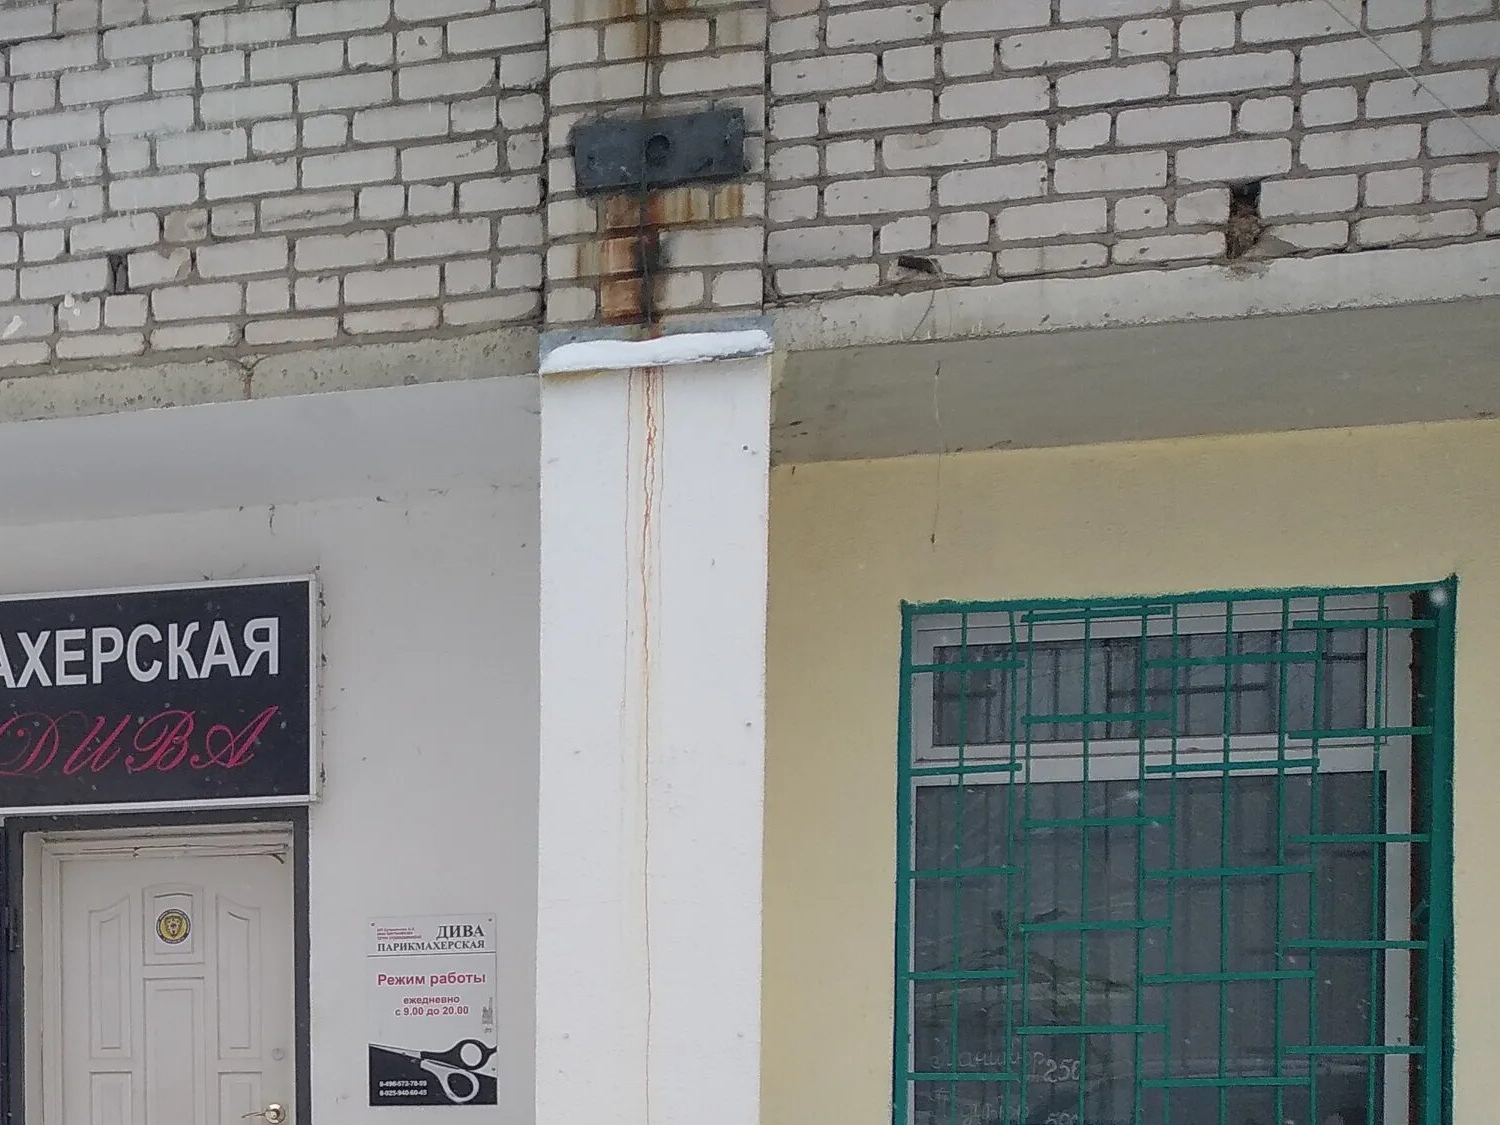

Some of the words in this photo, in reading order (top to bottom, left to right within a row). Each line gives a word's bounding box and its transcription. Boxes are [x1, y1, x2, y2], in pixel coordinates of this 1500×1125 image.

[436, 924, 485, 940] ДИВА
[377, 940, 485, 952] ПАРИКМАХЕРСКАЯ
[377, 974, 425, 986] Режим
[430, 972, 486, 987] работы
[403, 996, 460, 1005] ежедневно
[403, 1007, 424, 1016] 9.00
[426, 1007, 440, 1016] до
[442, 1006, 469, 1015] 20.00
